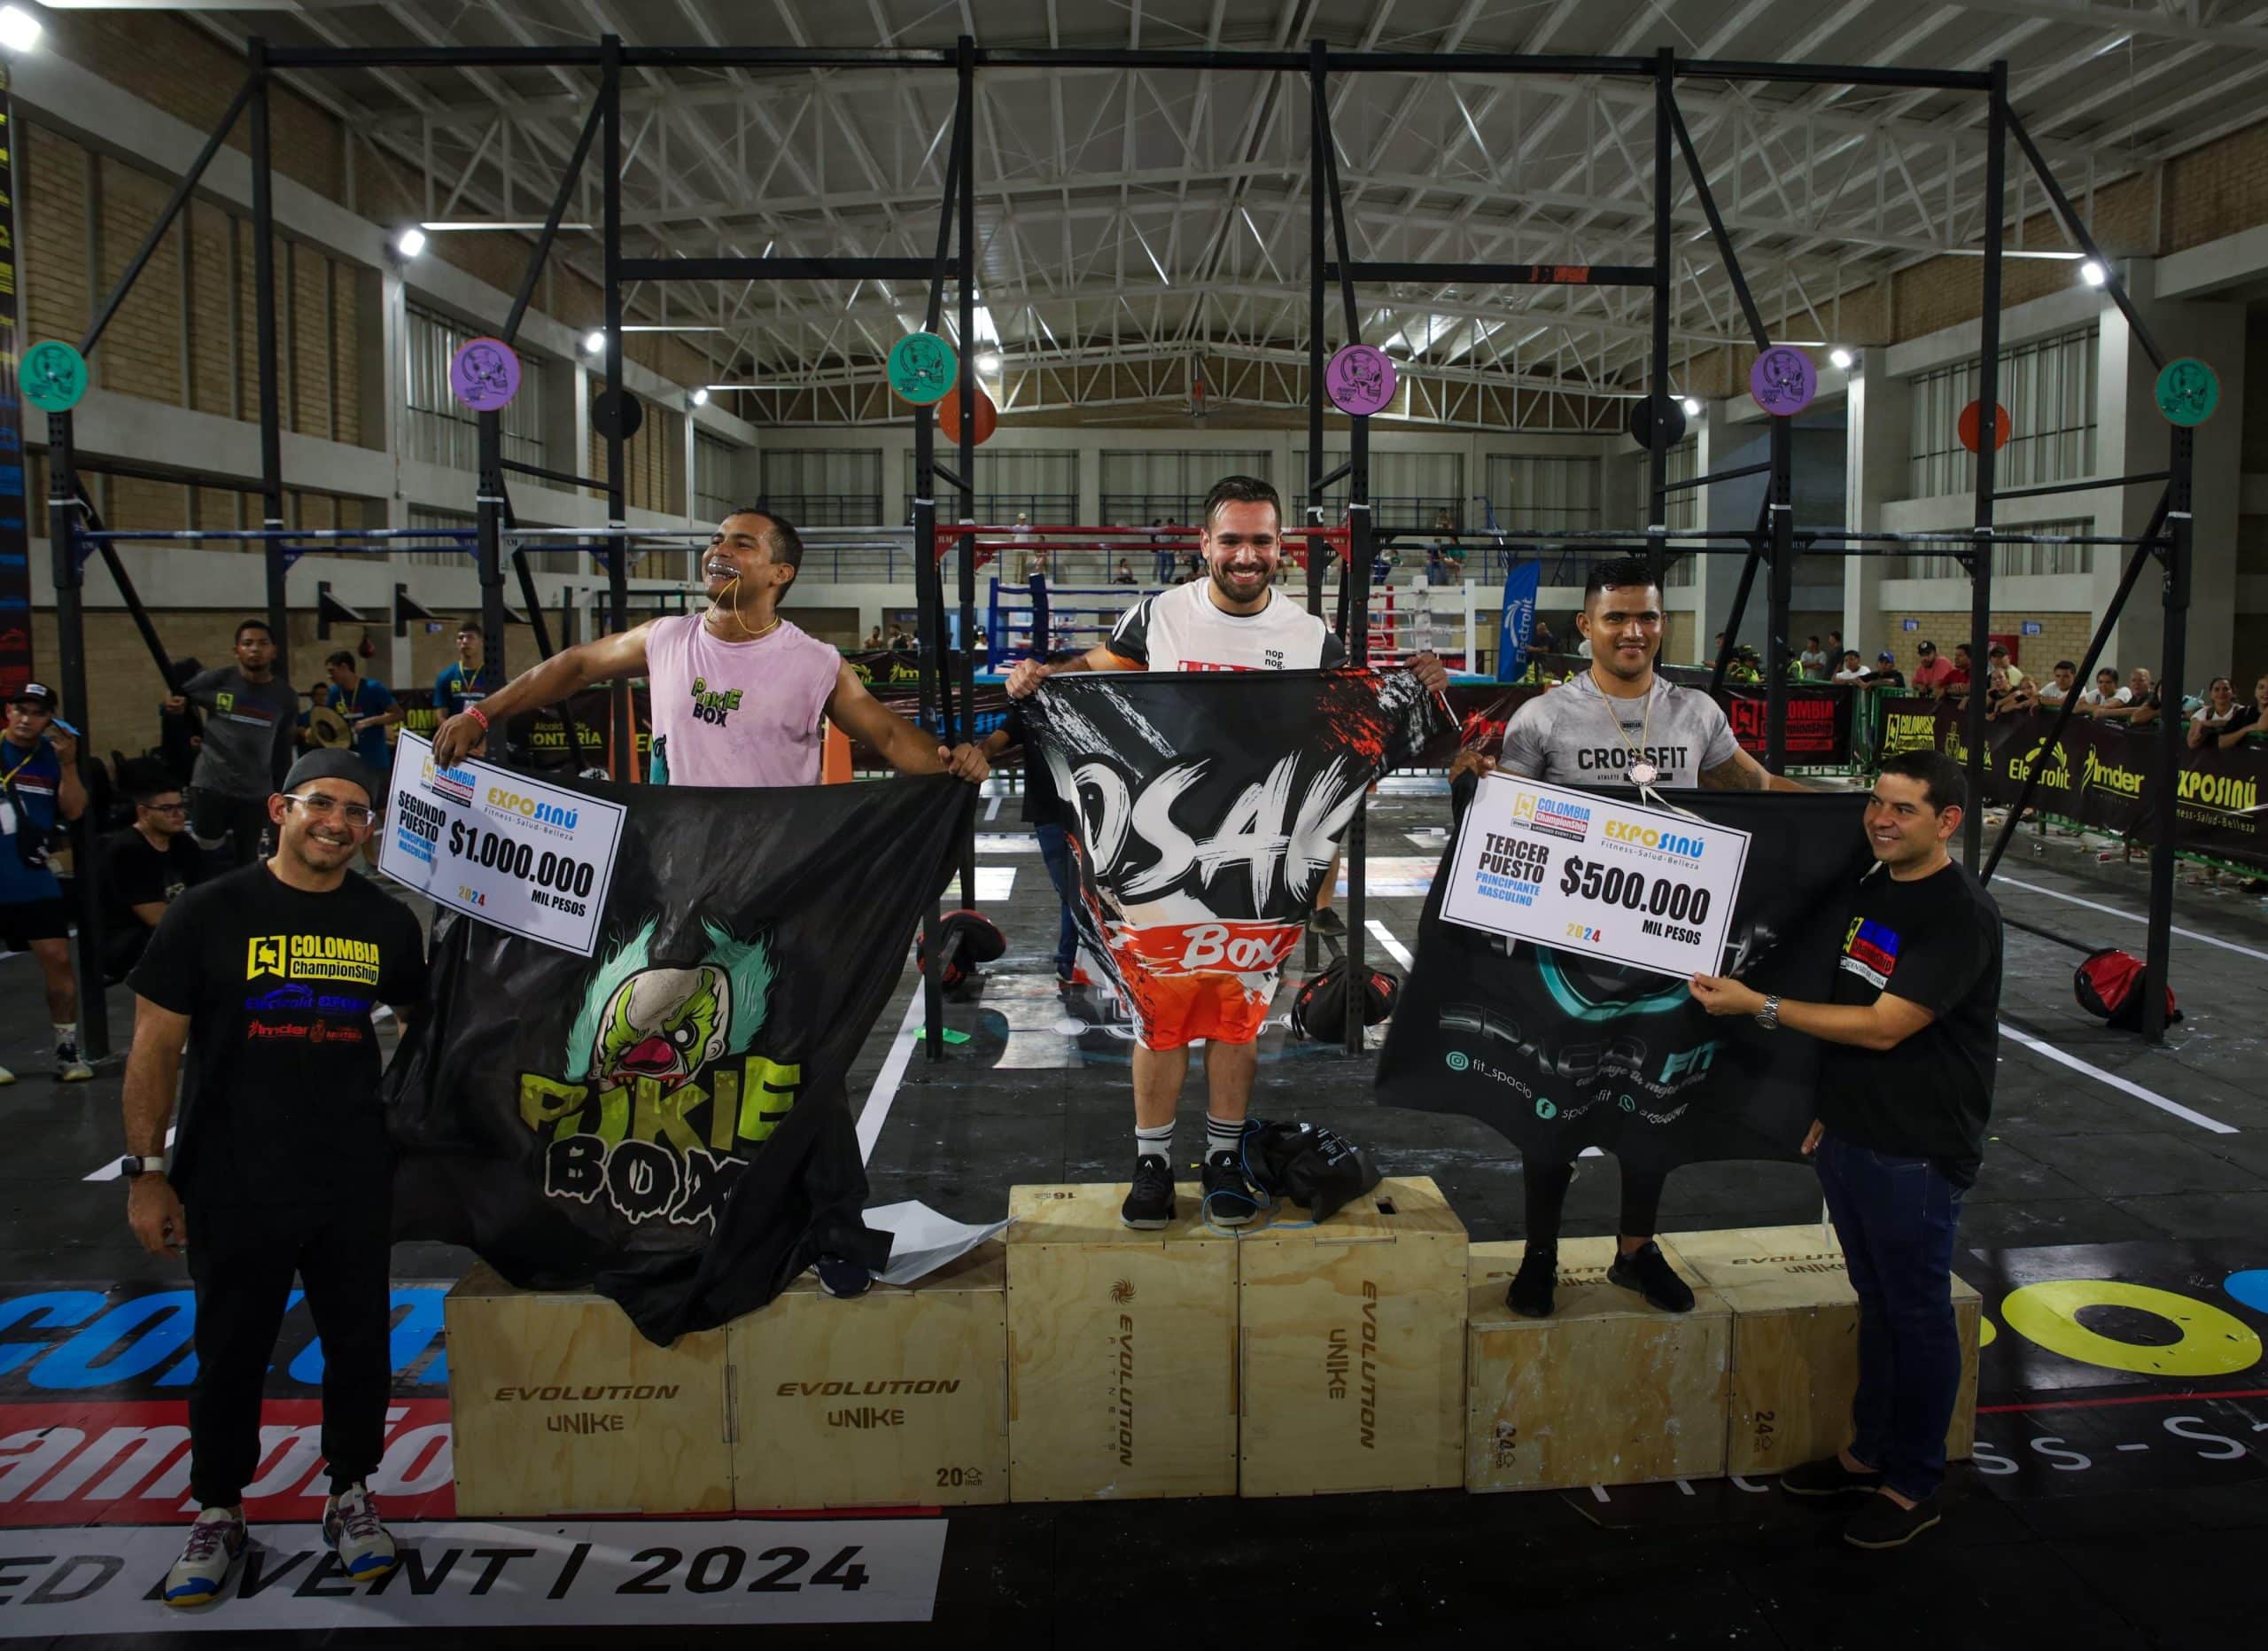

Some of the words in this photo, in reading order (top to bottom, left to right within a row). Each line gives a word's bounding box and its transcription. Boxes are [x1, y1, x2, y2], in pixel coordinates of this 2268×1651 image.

[1516, 596, 1533, 663] Electrolit
[1265, 649, 1284, 659] nop
[693, 703, 727, 727] BOX
[528, 728, 602, 745] ONTRÍA
[436, 765, 476, 787] CLOMBIA
[2008, 756, 2071, 790] Elerolit
[2092, 759, 2145, 794] Imder
[2177, 768, 2257, 809] XPOSINÚ
[399, 790, 447, 829] SEGUNDO
[1537, 798, 1591, 821] COLOMBIA
[399, 810, 439, 844] PUESTO
[1604, 819, 1705, 859] EXPOSINÚ
[448, 819, 595, 898] $1.000.000
[1486, 833, 1550, 865] TERCER
[1479, 852, 1546, 884] PUESTO
[458, 885, 485, 907] 2024
[1475, 871, 1541, 897] PRINCIPIANTE
[1477, 884, 1533, 907] MASCULINO
[1560, 855, 1712, 925] $500.000
[532, 889, 550, 905] MIL
[551, 895, 586, 917] PESOS
[1565, 923, 1601, 943] 2024
[1643, 920, 1663, 937] MIL
[1665, 925, 1702, 945] PESOS
[291, 934, 380, 965] COLOMBIA
[292, 961, 377, 983] ChampionShip
[1472, 1057, 1533, 1099] fit_spacio
[519, 1055, 802, 1156] PUKIE
[1732, 1252, 1846, 1265] EVOLUT
[1559, 1276, 1610, 1287] NIKE
[1327, 1328, 1349, 1401] UNIKE
[1361, 1280, 1378, 1451] EVOLUTION
[494, 1383, 680, 1403] EVOLUTION
[776, 1378, 961, 1398] EVOLUTION
[1119, 1313, 1133, 1468] EVOLUTION
[547, 1413, 625, 1435] UNIKE
[827, 1407, 905, 1429] UNIKE
[1756, 1411, 1774, 1435] 24
[936, 1467, 964, 1487] 20
[142, 1548, 538, 1601] VENT
[615, 1546, 870, 1594] 2024
